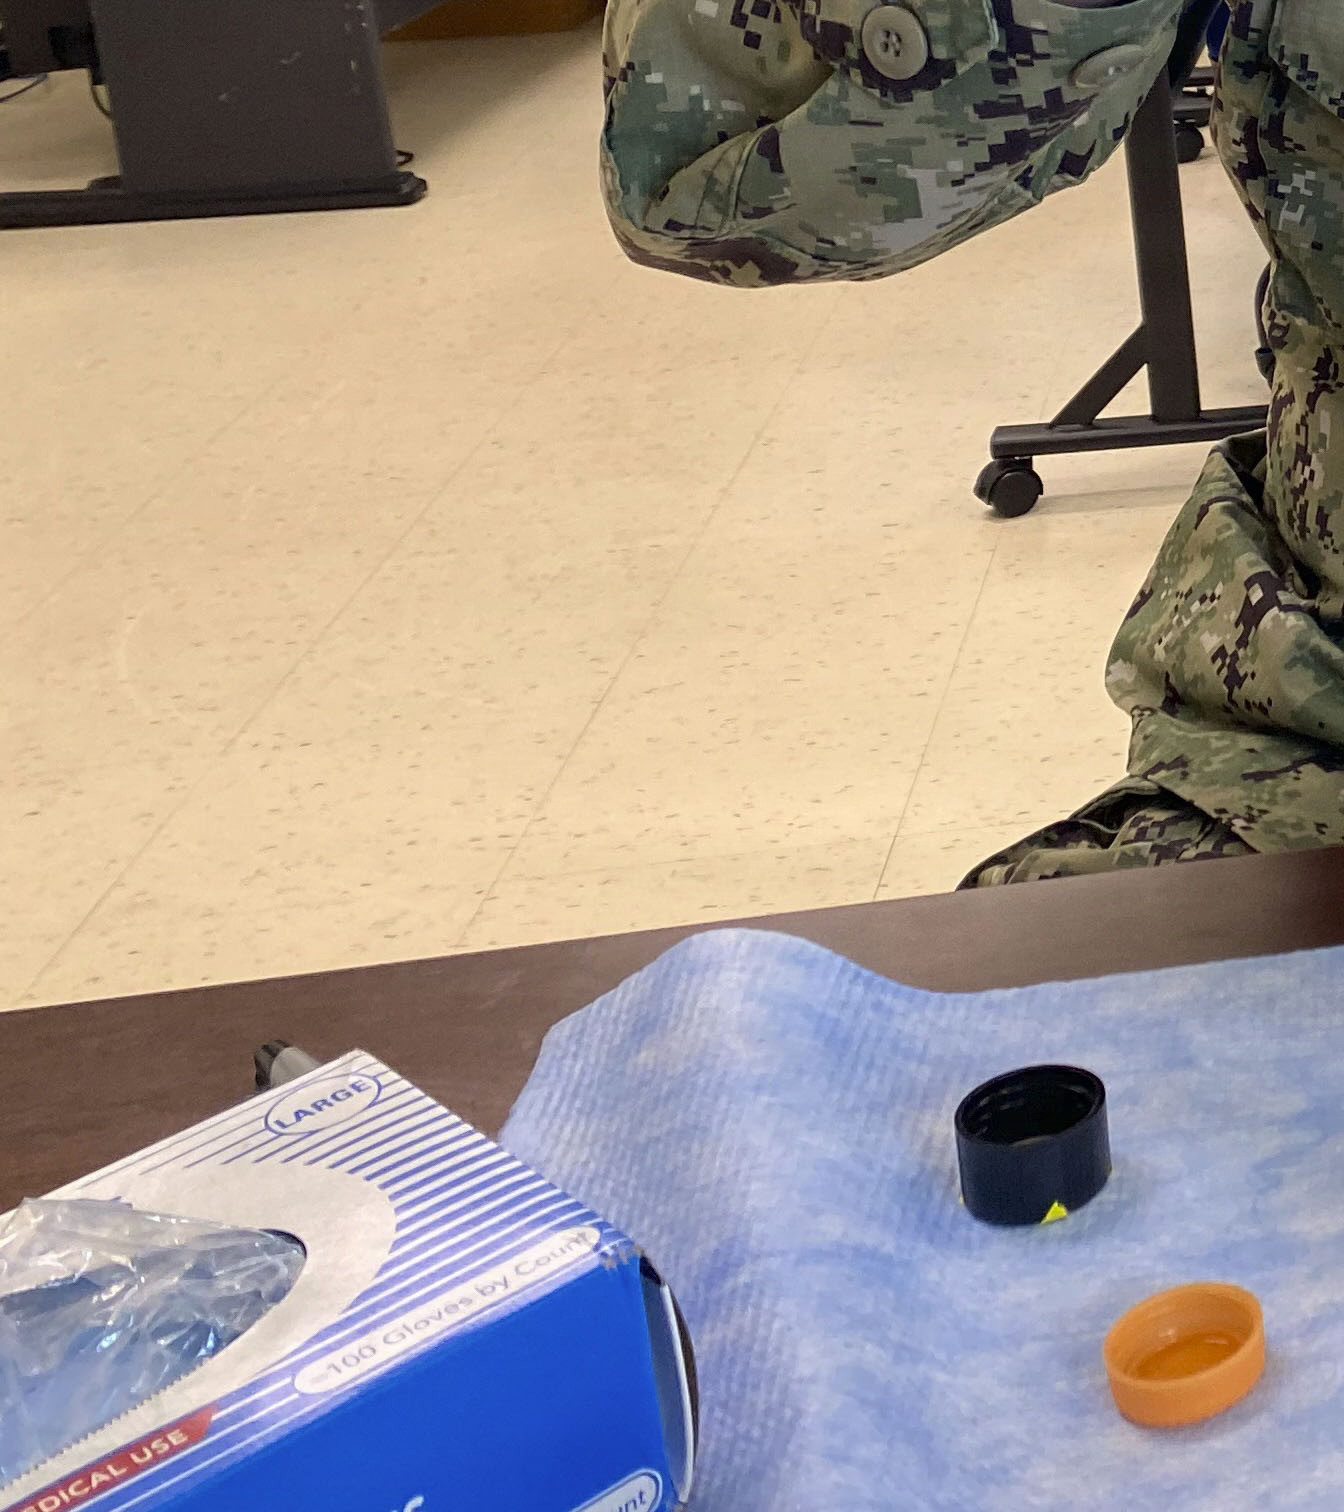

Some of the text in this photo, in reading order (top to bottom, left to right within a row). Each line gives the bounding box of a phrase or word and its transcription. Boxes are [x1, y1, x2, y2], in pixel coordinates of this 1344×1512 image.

[273, 1080, 372, 1129] LARGE
[382, 1295, 474, 1346] Gloves
[474, 1274, 510, 1298] by
[514, 1231, 588, 1276] Count
[21, 1428, 188, 1512] DICAL USE
